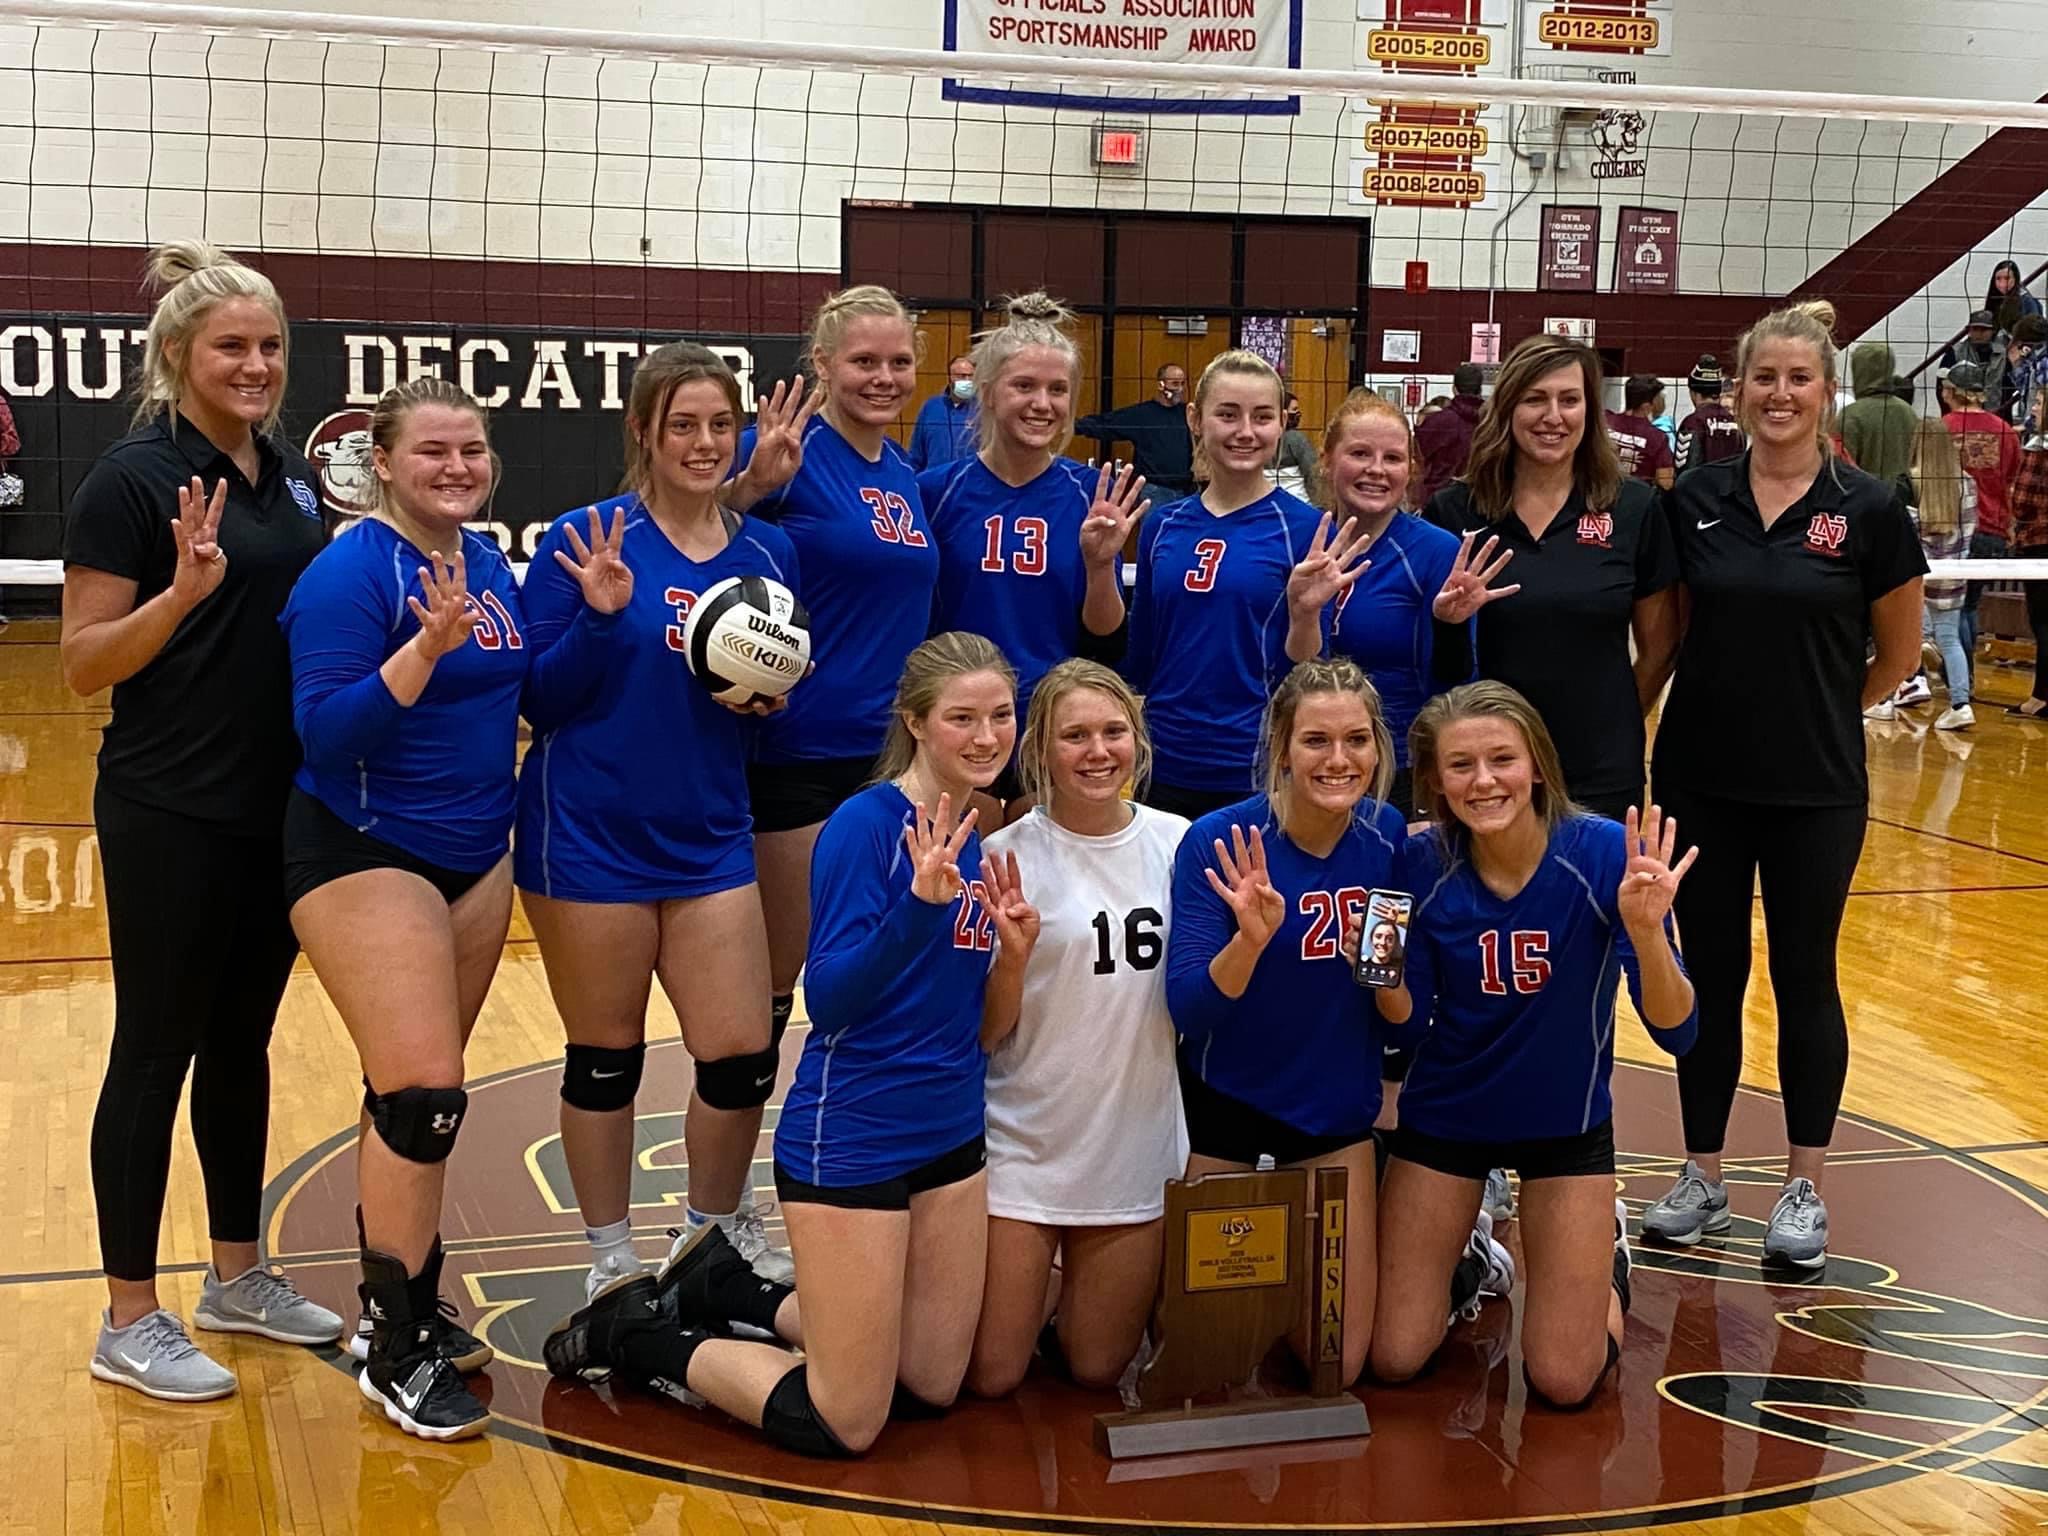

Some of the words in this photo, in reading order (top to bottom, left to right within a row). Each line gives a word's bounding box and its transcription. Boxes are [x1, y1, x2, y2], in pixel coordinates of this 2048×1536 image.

[1123, 0, 1255, 18] ASSOCIATION
[1545, 19, 1653, 41] 2012-2013
[989, 16, 1168, 51] SPORTSMANSHIP
[1188, 28, 1257, 52] AWARD
[1374, 36, 1485, 58] 2005-2006
[1370, 128, 1482, 150] 2007-2008
[1369, 174, 1480, 195] 2008-2009
[1591, 160, 1645, 179] COUGARS
[344, 335, 758, 413] DECATR
[860, 487, 929, 548] 32
[982, 514, 1049, 576] 13
[1184, 539, 1227, 592] 3
[748, 615, 801, 650] Wilson
[954, 878, 993, 952] 22
[1092, 907, 1163, 975] 16
[1479, 930, 1552, 995] 15
[1321, 1205, 1342, 1356] IHSAA
